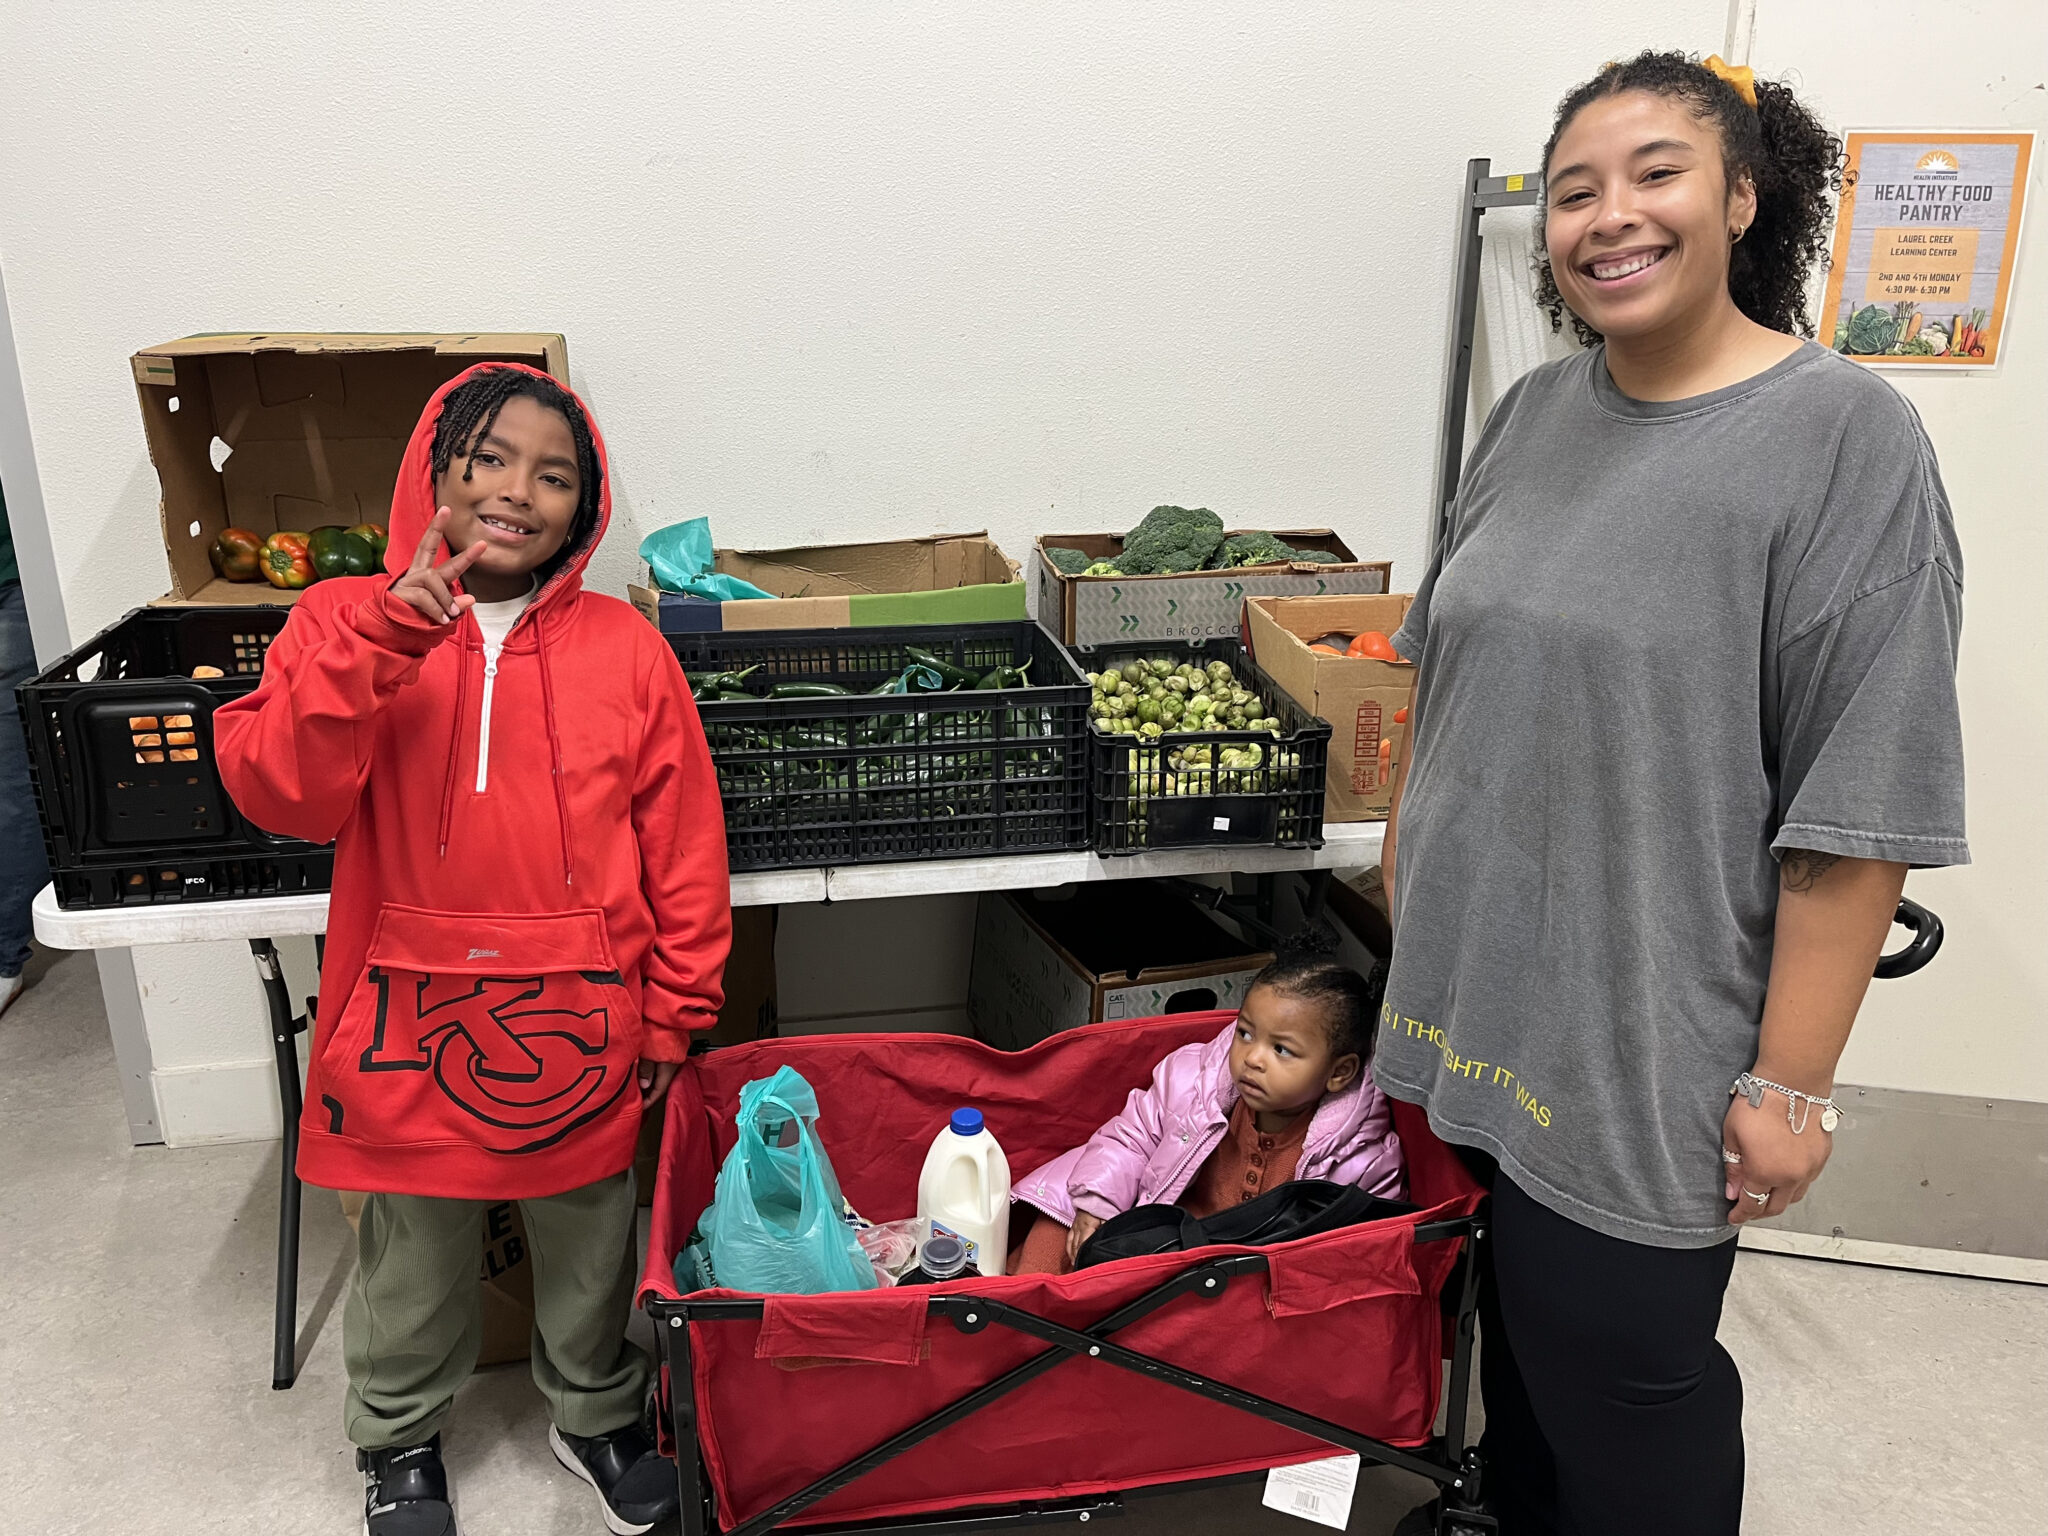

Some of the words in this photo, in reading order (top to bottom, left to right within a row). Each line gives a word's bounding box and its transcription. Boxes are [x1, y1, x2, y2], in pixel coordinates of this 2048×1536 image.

[1875, 185, 1947, 201] HEALTHY
[1952, 185, 1993, 201] FOOD
[1899, 204, 1963, 221] PANTRY
[1898, 235, 1927, 243] LAUREL
[1929, 235, 1954, 243] CREEK
[1890, 248, 1927, 256] LEARNING
[1928, 248, 1957, 256] CENTER
[1912, 273, 1928, 281] 4TH
[1929, 273, 1961, 282] MONDAY
[1885, 285, 1903, 293] 4:30
[1920, 286, 1937, 294] 6:30
[1493, 1066, 1515, 1089] IT
[1515, 1080, 1552, 1127] WAS
